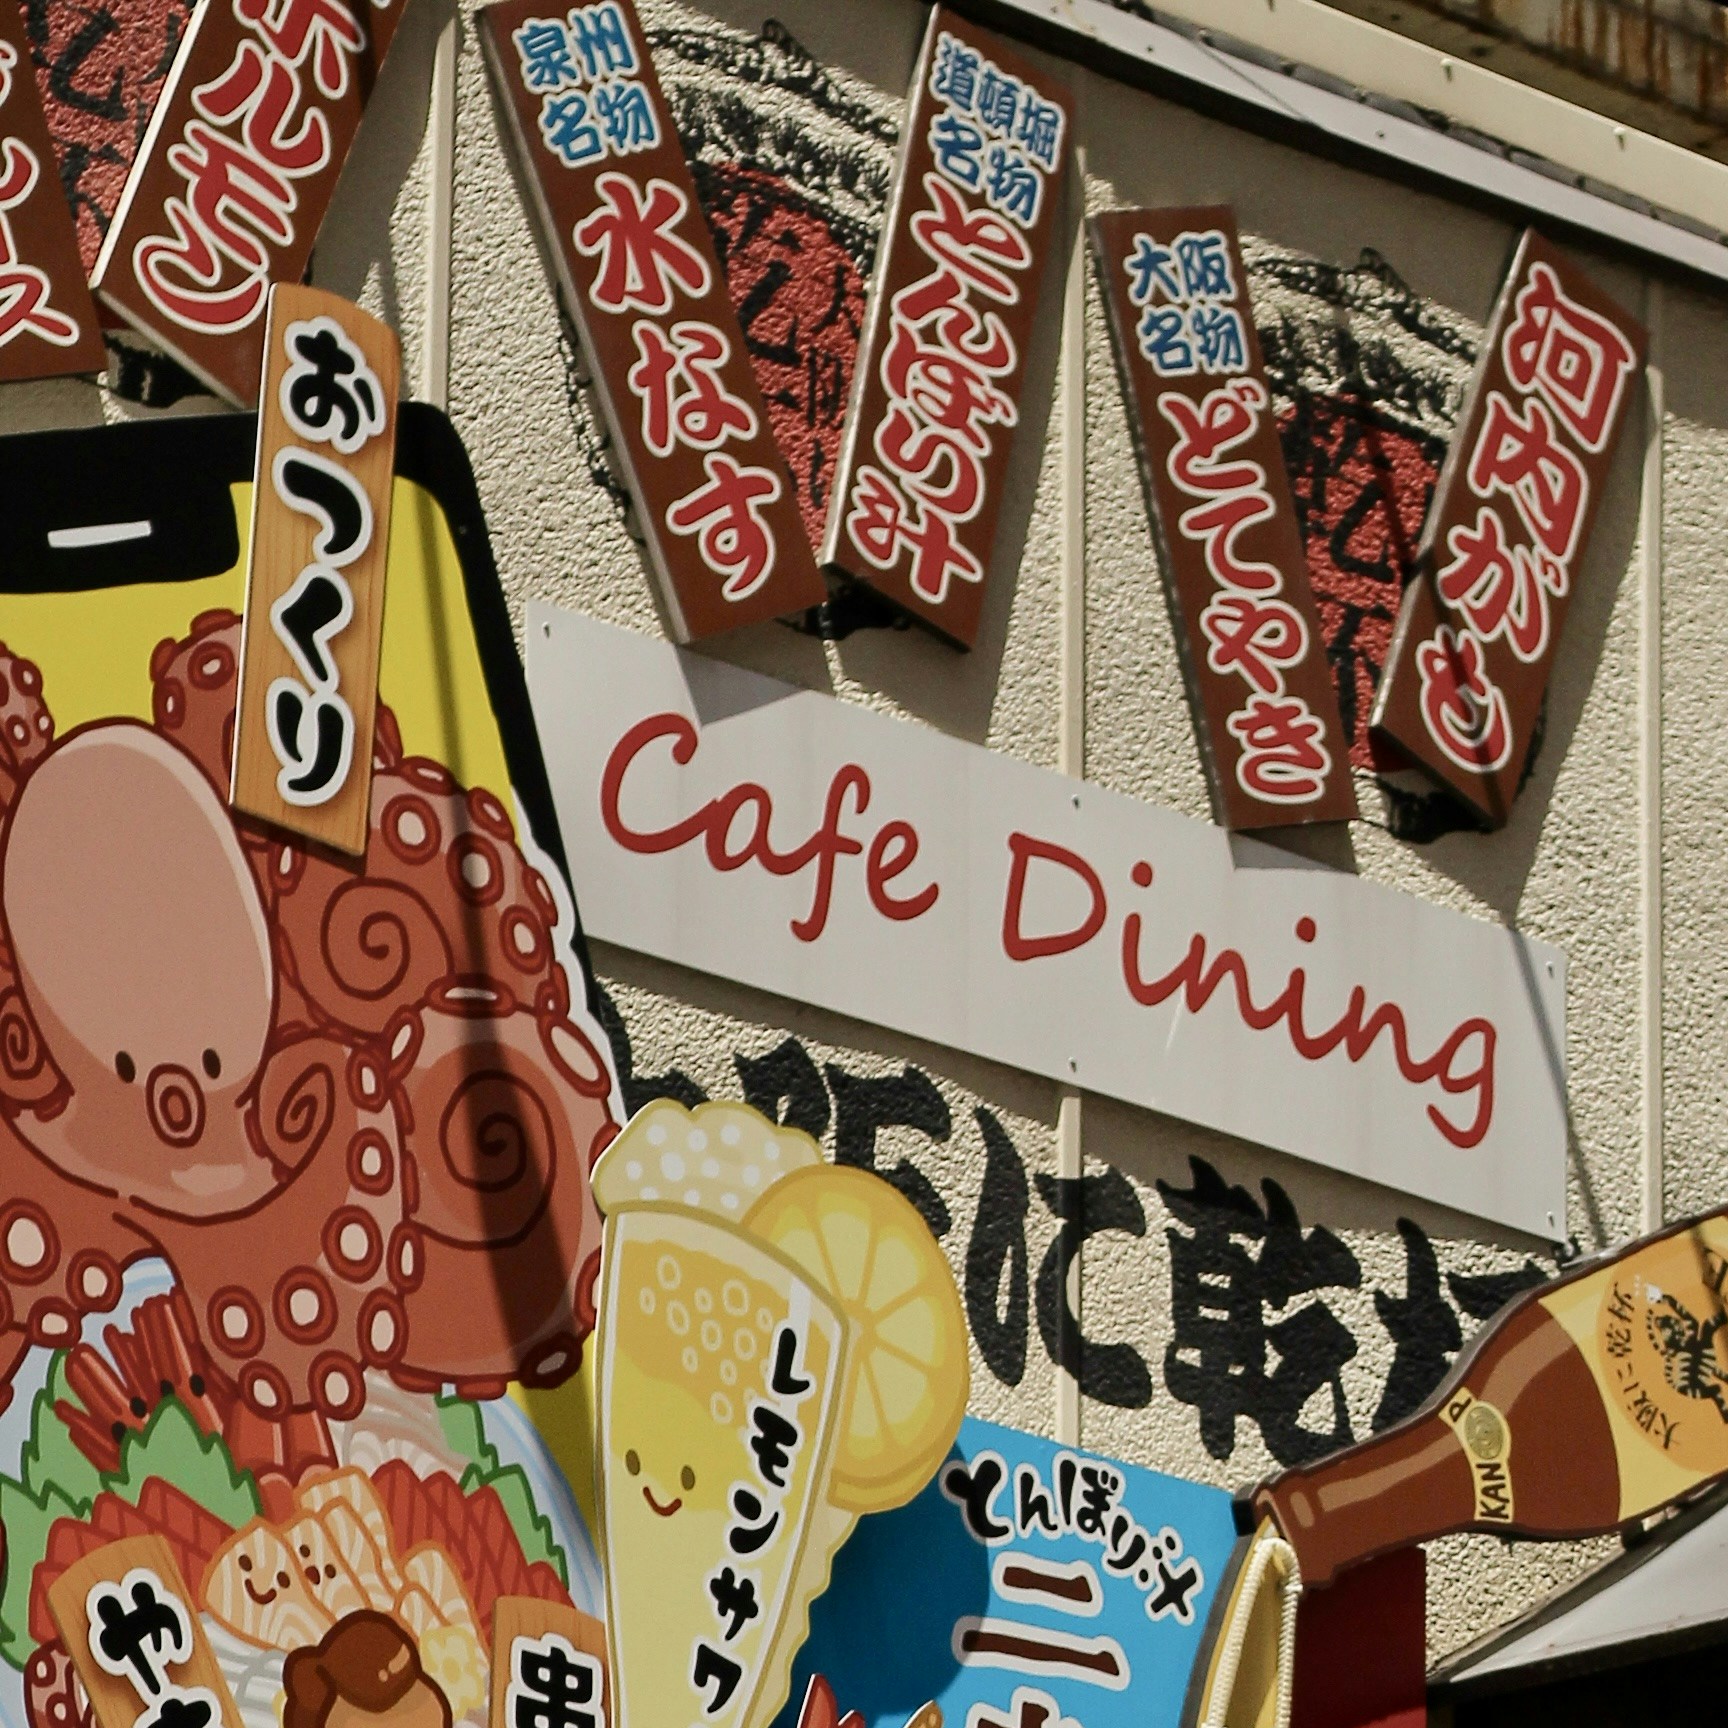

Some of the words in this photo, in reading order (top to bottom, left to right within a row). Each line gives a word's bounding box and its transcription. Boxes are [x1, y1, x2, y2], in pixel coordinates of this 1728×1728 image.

[516, 5, 637, 92] 泉州
[932, 38, 1069, 170] 道頓堀
[541, 78, 661, 168] 名物
[930, 116, 1044, 228] 名物
[1125, 228, 1237, 304] 大阪
[573, 172, 783, 602] 水なす
[1136, 298, 1249, 378] 名物
[266, 316, 387, 806] おつくり
[1157, 376, 1332, 804] どてやき
[600, 709, 938, 943] Cafe
[1006, 832, 1497, 1148] Dining
